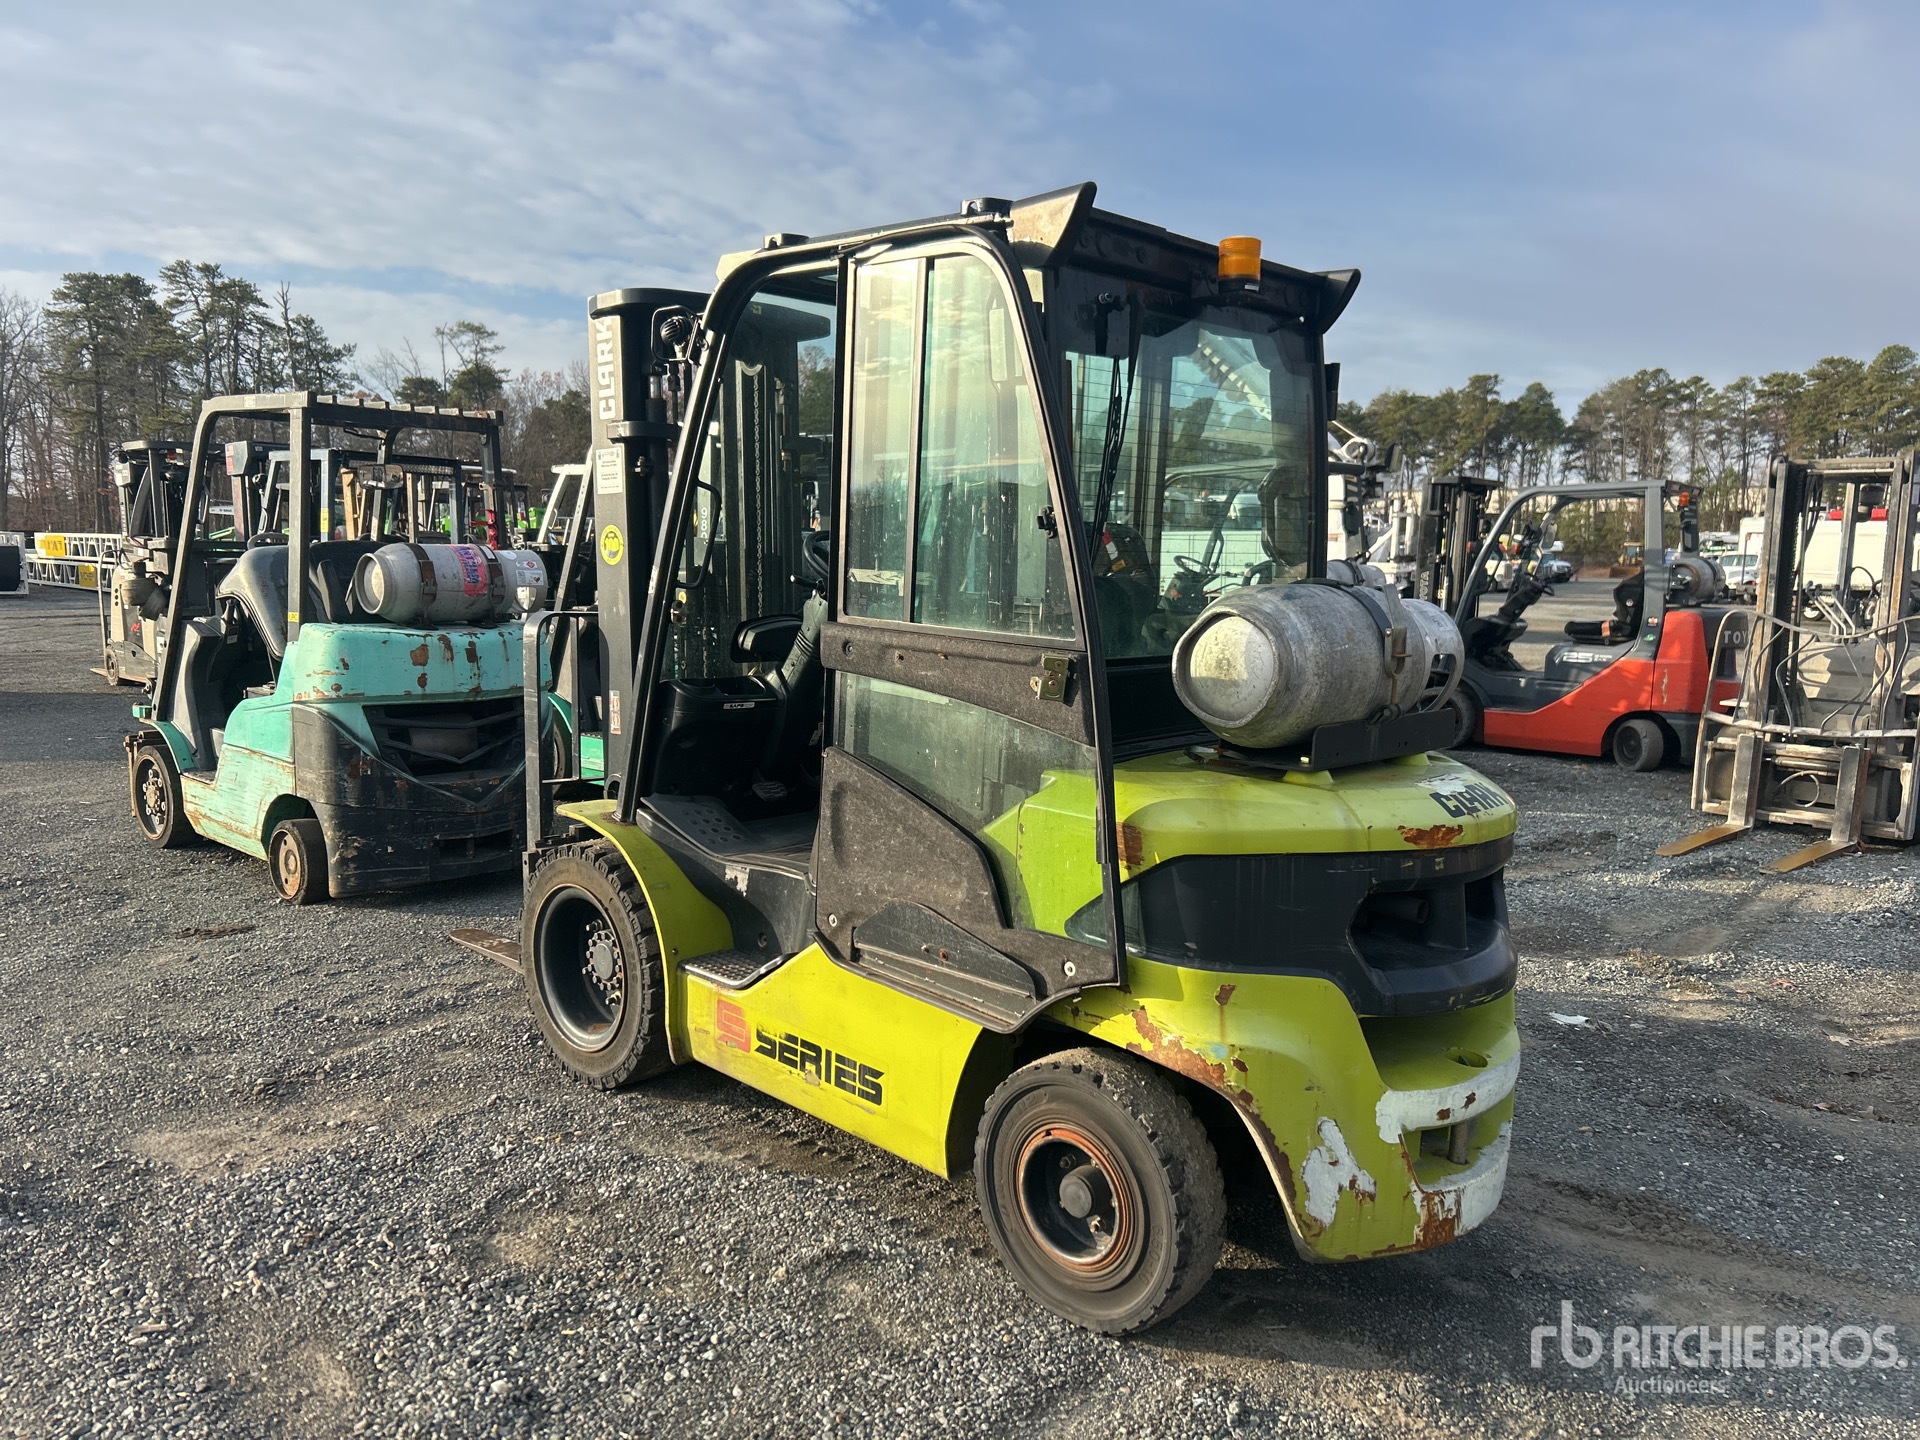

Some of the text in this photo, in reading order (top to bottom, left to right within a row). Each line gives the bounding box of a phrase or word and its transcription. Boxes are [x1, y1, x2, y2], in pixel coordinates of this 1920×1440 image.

[595, 315, 616, 420] CLARK
[1723, 630, 1748, 644] TOY
[1562, 652, 1594, 663] 25
[1429, 782, 1509, 818] CLARK
[754, 1024, 885, 1106] SERIES
